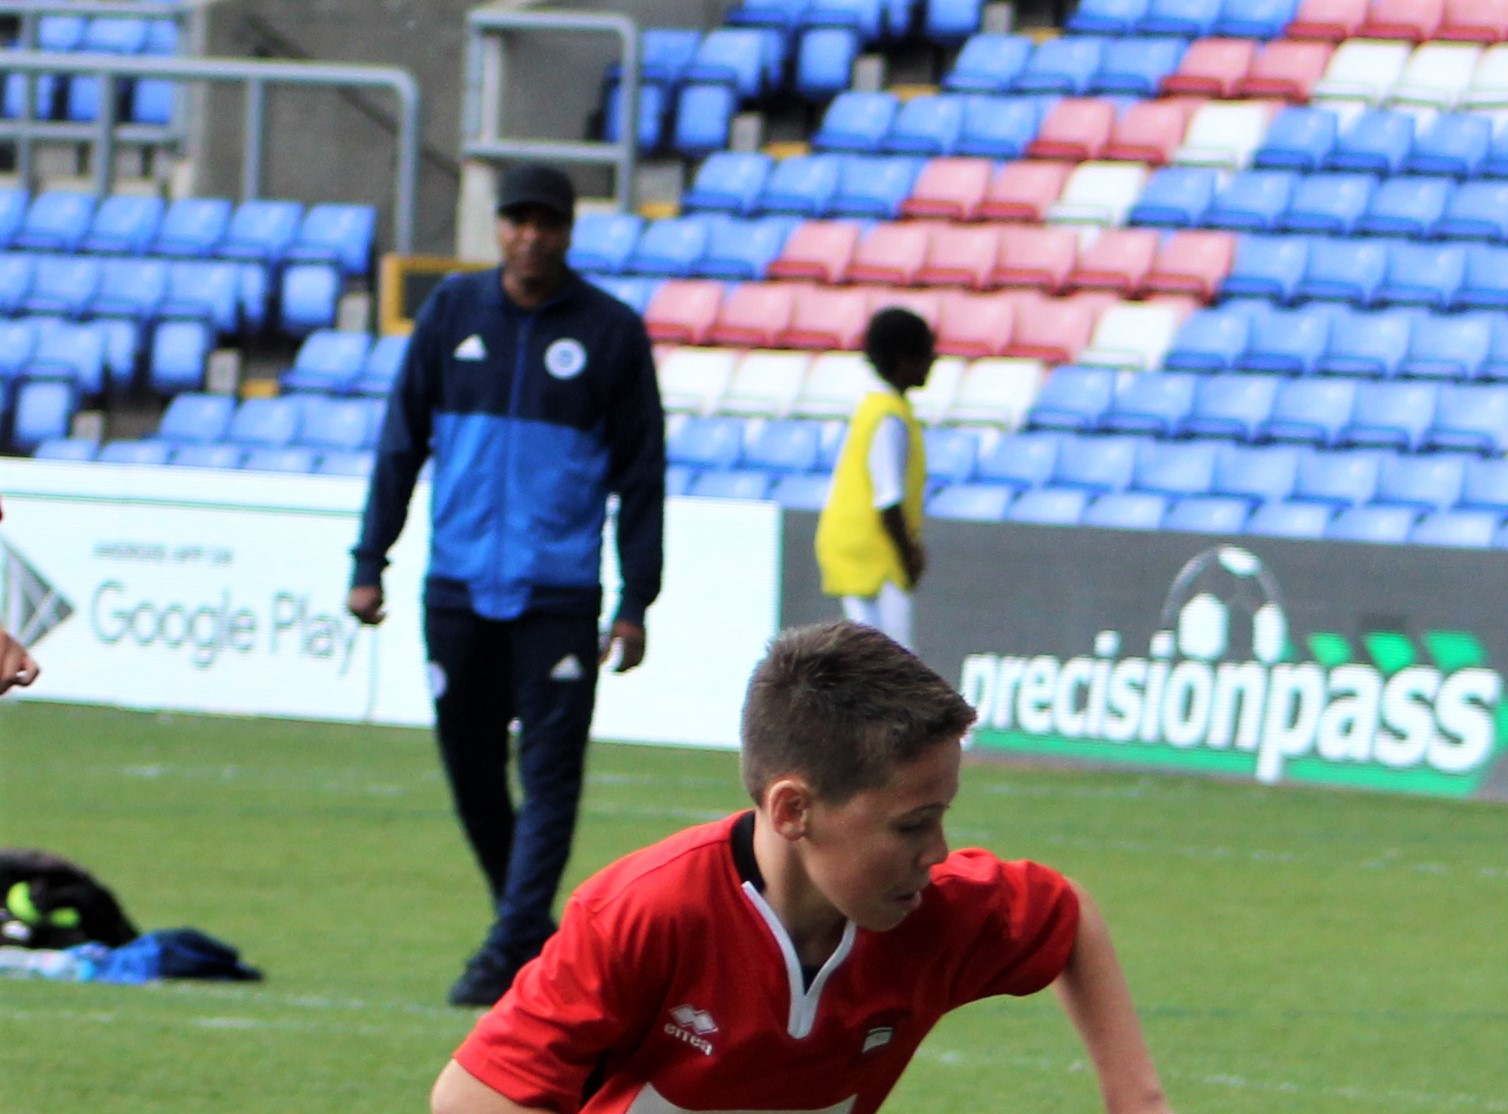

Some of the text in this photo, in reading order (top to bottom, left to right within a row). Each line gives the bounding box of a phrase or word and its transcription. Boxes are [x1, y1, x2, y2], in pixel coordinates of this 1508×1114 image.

[92, 581, 358, 678] Google Play
[960, 630, 1502, 783] precisionpass
